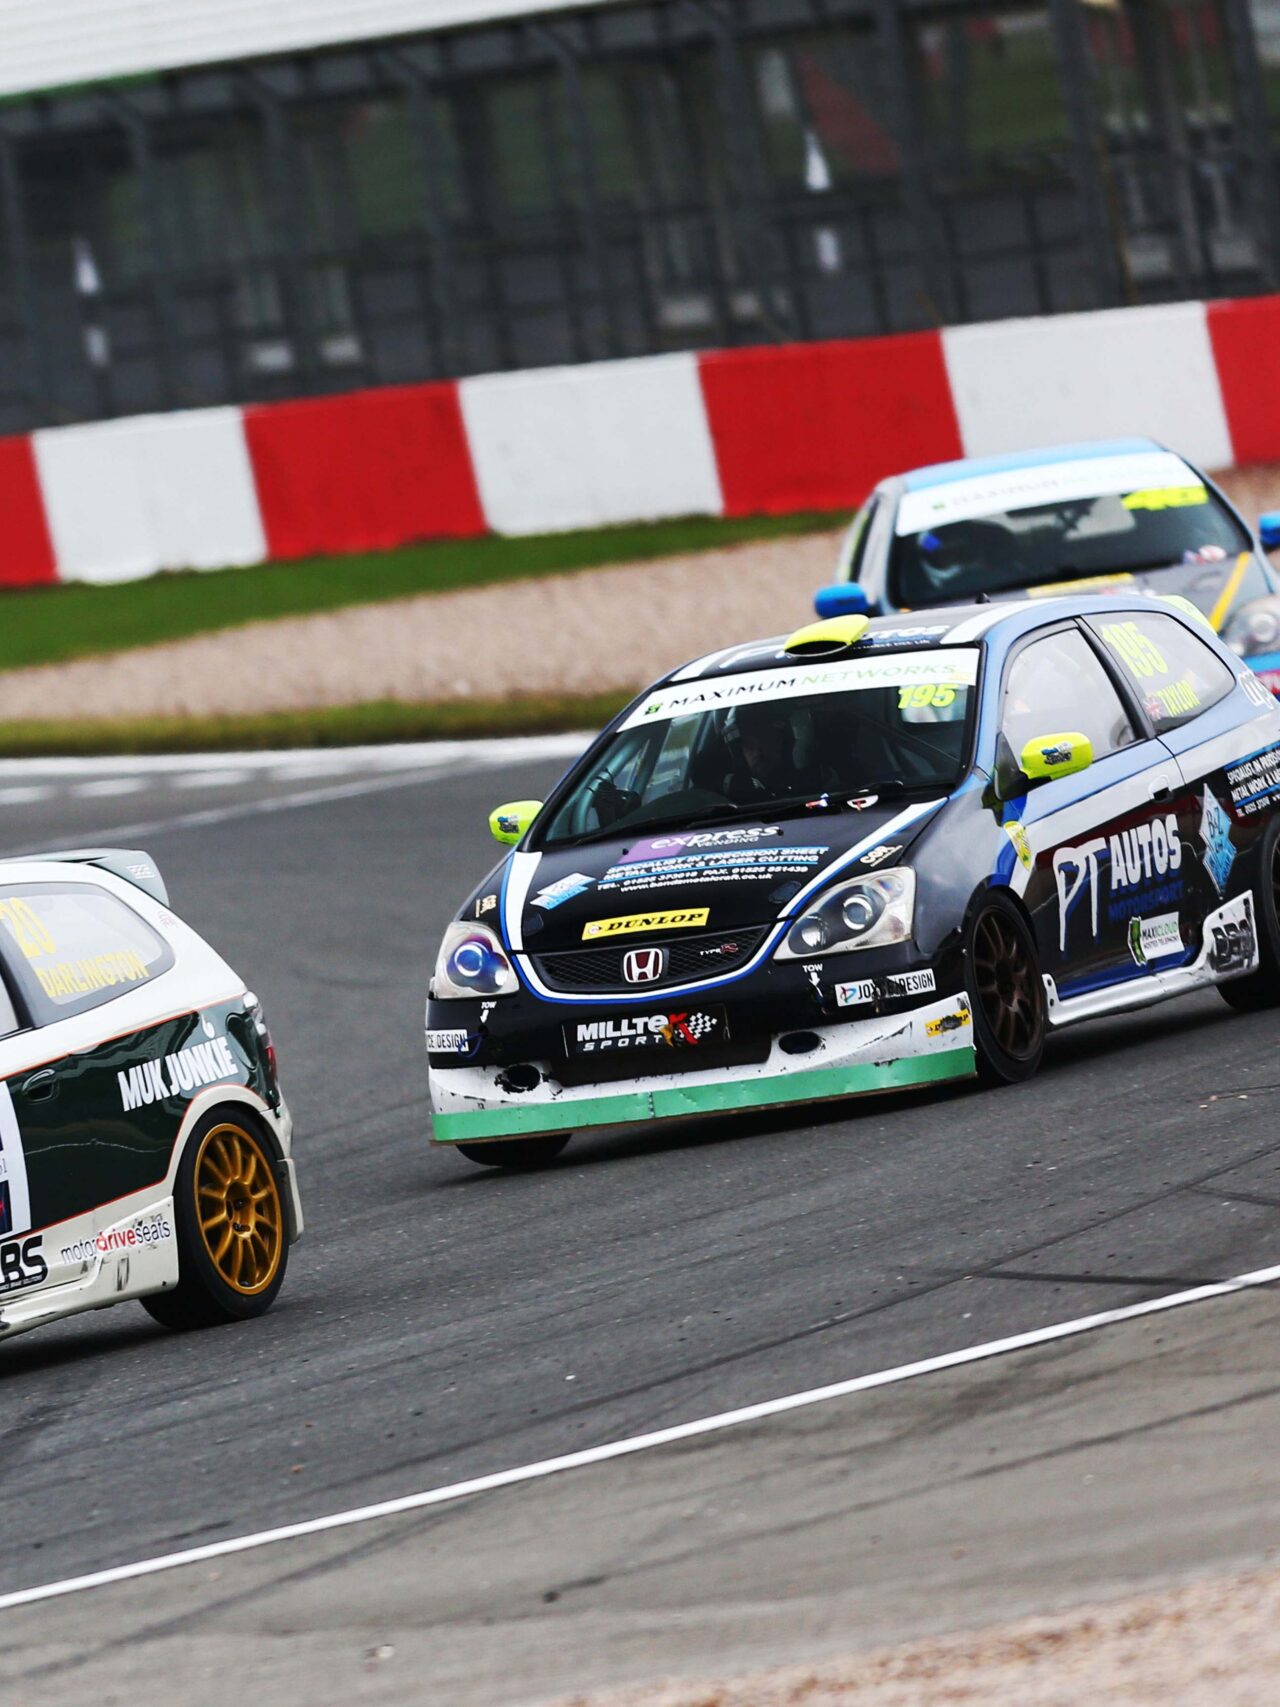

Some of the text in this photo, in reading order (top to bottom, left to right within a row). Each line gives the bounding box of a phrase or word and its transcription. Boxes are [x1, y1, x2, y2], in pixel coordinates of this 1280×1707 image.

[669, 678, 796, 709] MAXIMUM
[801, 664, 956, 685] NETWORKS
[897, 684, 958, 710] 195
[651, 826, 780, 849] express
[699, 836, 759, 848] VENDING
[603, 868, 646, 880] METAL
[651, 862, 694, 873] WORK
[709, 857, 756, 867] LASER
[758, 854, 820, 863] CUTTING
[606, 846, 830, 874] SPECIALIST IN PRECISION SHEET
[1053, 837, 1107, 952] PT
[1110, 814, 1183, 890] AUTOS
[605, 912, 704, 932] DUNLOP
[34, 949, 150, 998] DARLINGTON
[803, 963, 823, 973] TOW
[583, 1035, 663, 1052] SPORT
[117, 1036, 238, 1111] MUK JUNKIE
[61, 1220, 171, 1265] motordriveseats
